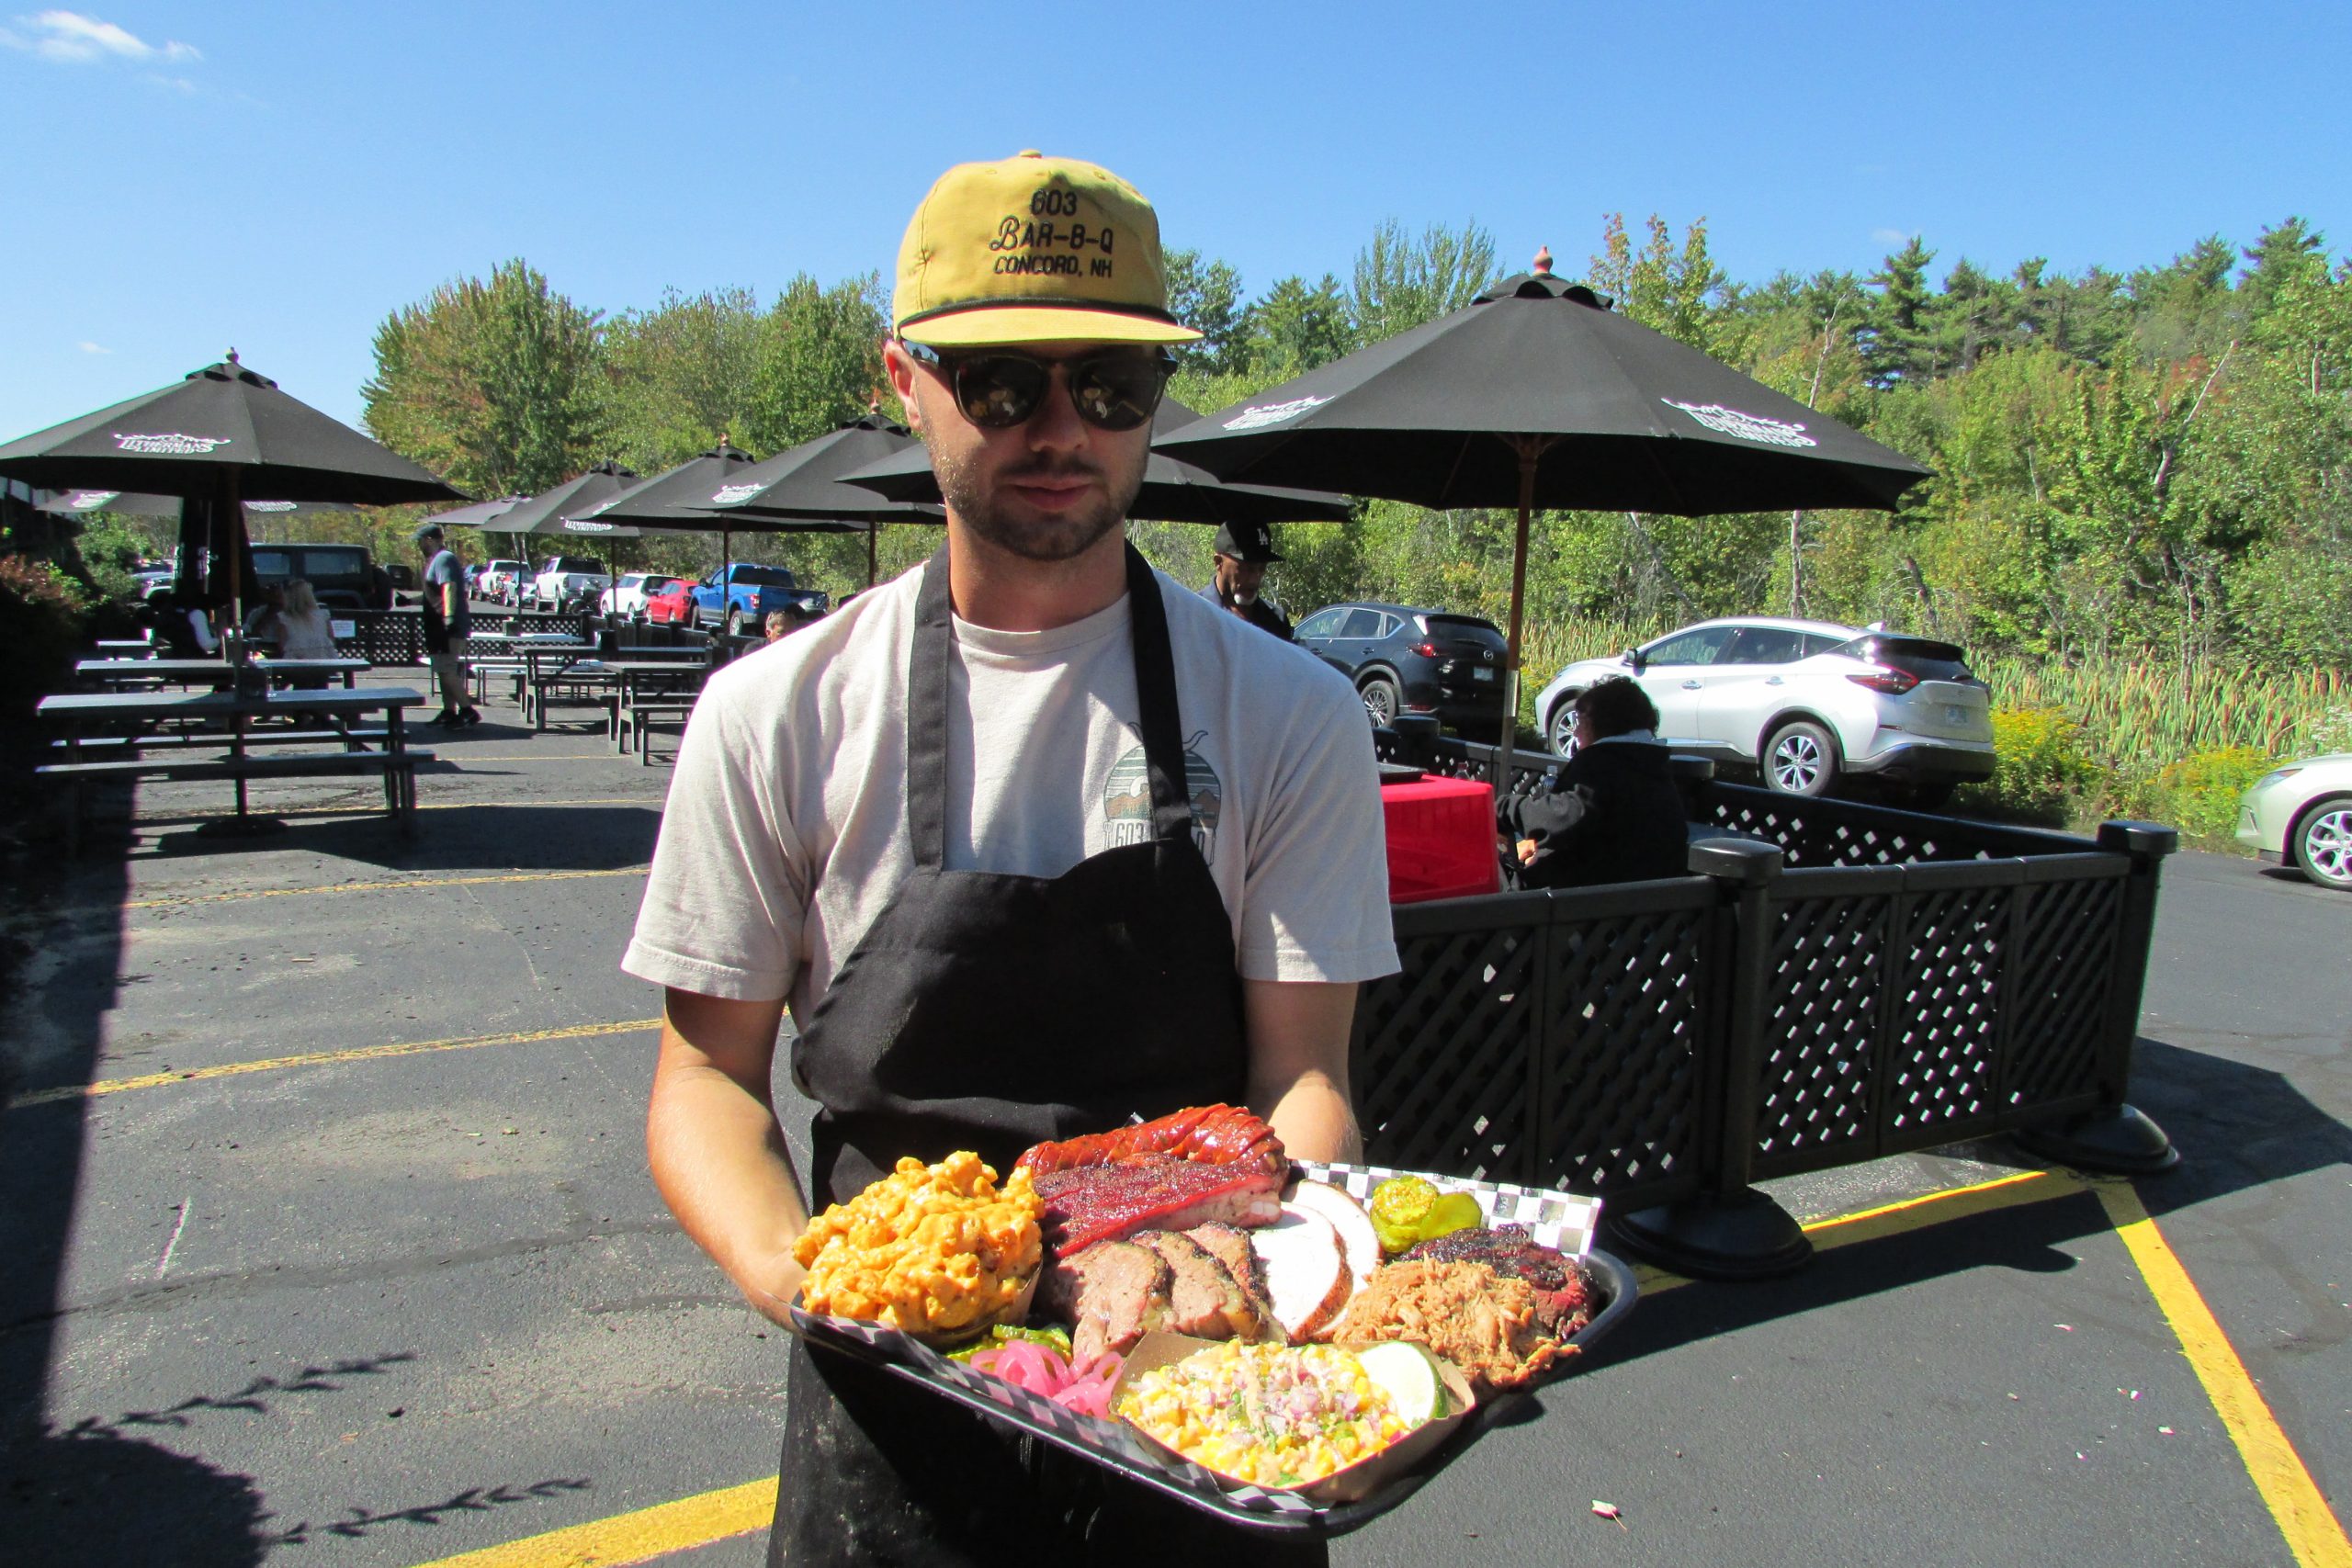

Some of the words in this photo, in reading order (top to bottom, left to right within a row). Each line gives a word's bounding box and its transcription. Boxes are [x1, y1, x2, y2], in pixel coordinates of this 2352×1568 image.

[1031, 187, 1077, 216] 603
[989, 214, 1114, 254] BAR-B-Q
[994, 255, 1082, 276] CONCORD,
[1091, 258, 1112, 277] NH
[1257, 528, 1268, 546] LA
[1114, 822, 1145, 846] 603
